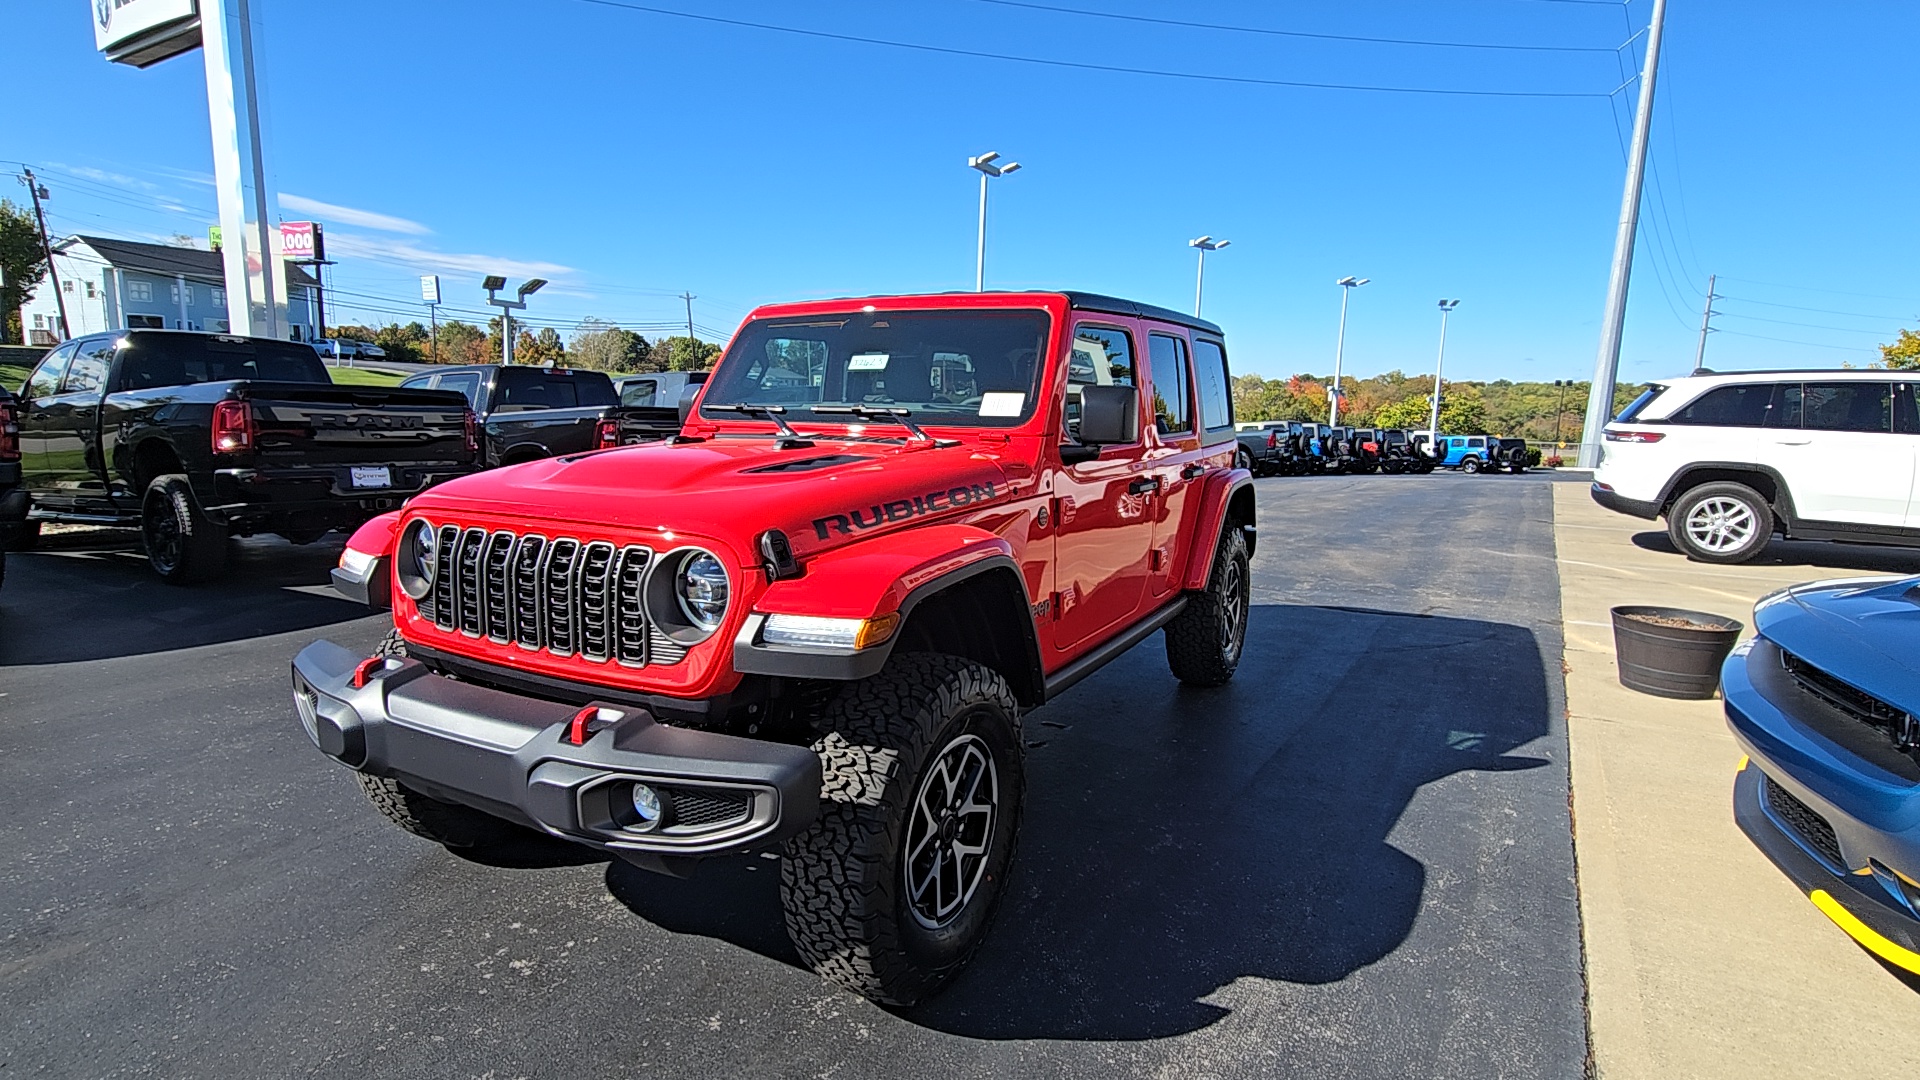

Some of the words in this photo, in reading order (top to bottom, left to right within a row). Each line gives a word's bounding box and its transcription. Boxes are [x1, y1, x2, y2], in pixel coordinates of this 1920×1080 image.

[310, 414, 424, 429] RAM
[812, 481, 996, 541] RUBICON
[1030, 599, 1050, 618] eep
